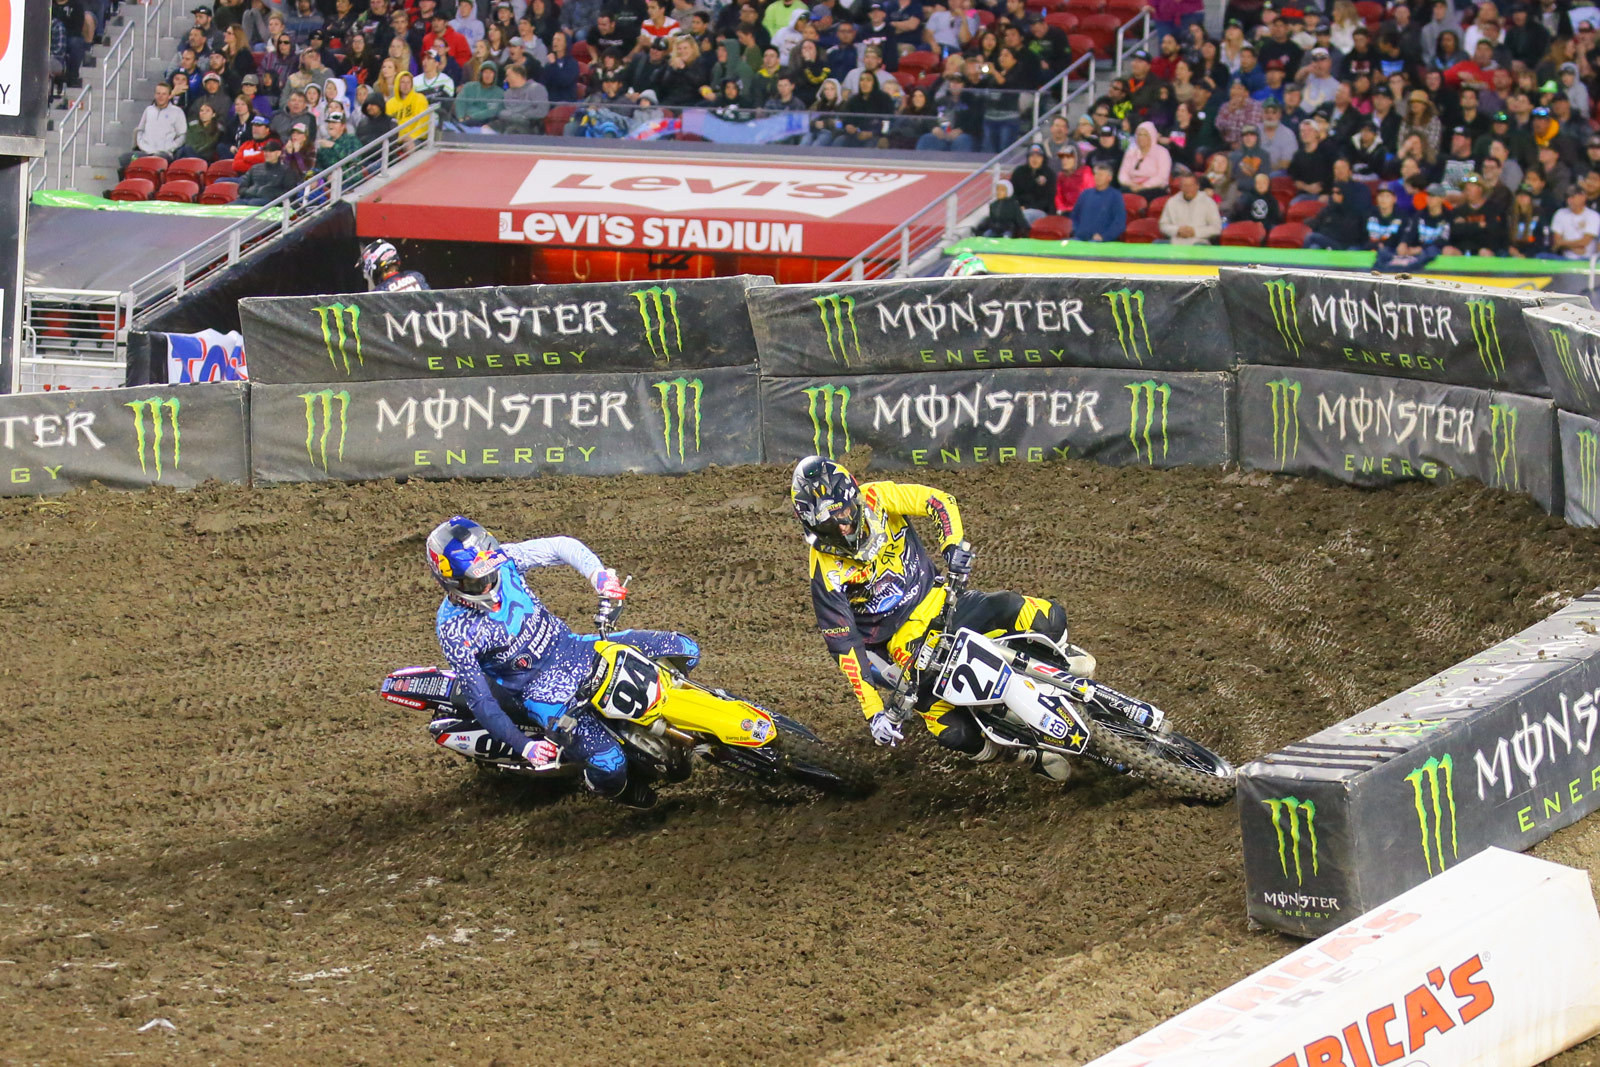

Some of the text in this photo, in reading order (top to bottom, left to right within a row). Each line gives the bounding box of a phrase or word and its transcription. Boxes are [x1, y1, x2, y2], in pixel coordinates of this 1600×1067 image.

[642, 217, 803, 252] STADIUM
[384, 300, 617, 348] MONSTER
[877, 293, 1095, 340] MONSTER
[1310, 289, 1459, 346] MONSTER
[428, 350, 587, 371] ENERGY
[920, 348, 1066, 364] ENERGY
[1343, 348, 1446, 371] ENERGY
[376, 386, 635, 440] MONSTER
[872, 382, 1104, 439] MONSTER
[1317, 387, 1476, 454] MONSTER
[414, 446, 598, 466] ENERGY
[912, 446, 1072, 465] ENERGY
[496, 628, 532, 663] Soaring
[612, 652, 659, 719] 94
[951, 639, 1004, 701] 21
[386, 694, 422, 708] DUNLOP
[1473, 688, 1600, 801] MONS
[1263, 891, 1341, 911] MONSTER
[1276, 909, 1330, 919] ENERGY
